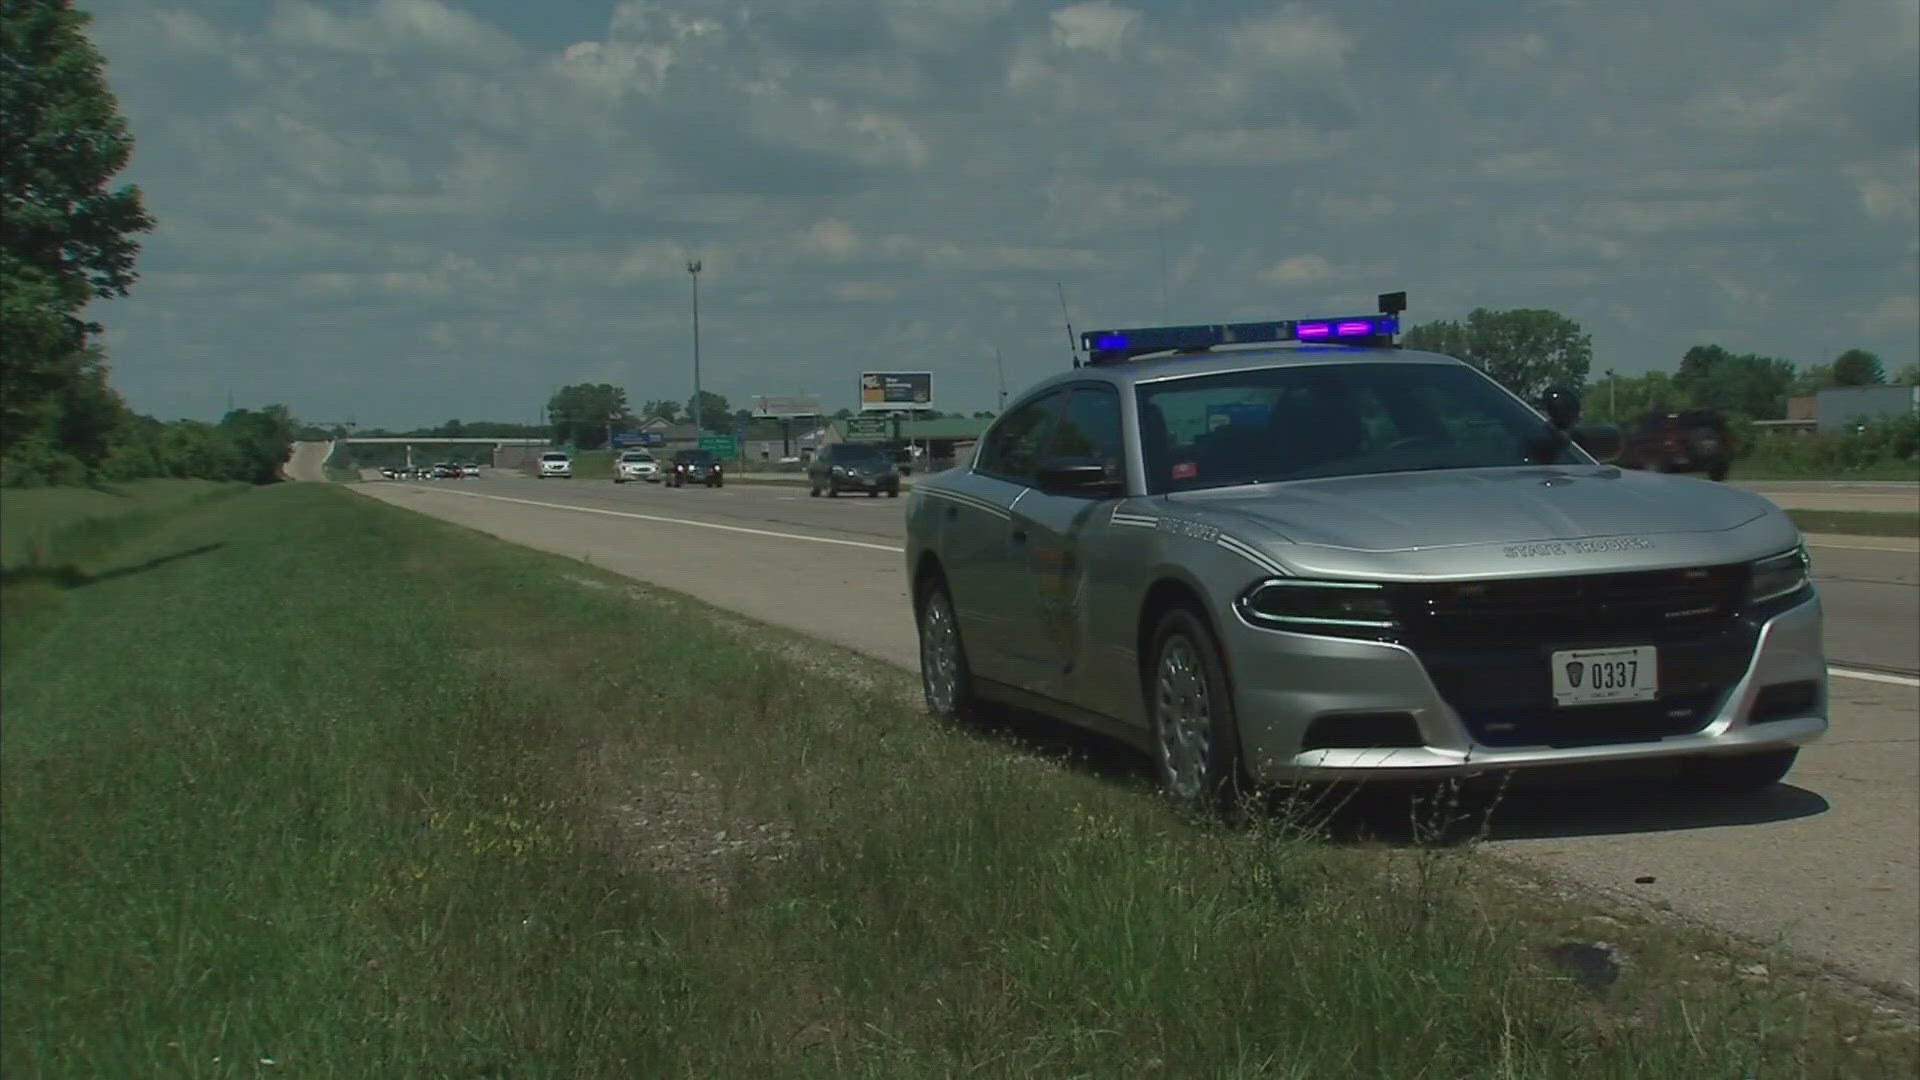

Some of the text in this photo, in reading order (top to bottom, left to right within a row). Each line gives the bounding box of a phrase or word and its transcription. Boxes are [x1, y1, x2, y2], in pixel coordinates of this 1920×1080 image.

[1504, 536, 1653, 559] STATE TROOPER
[1592, 661, 1637, 689] 0337
